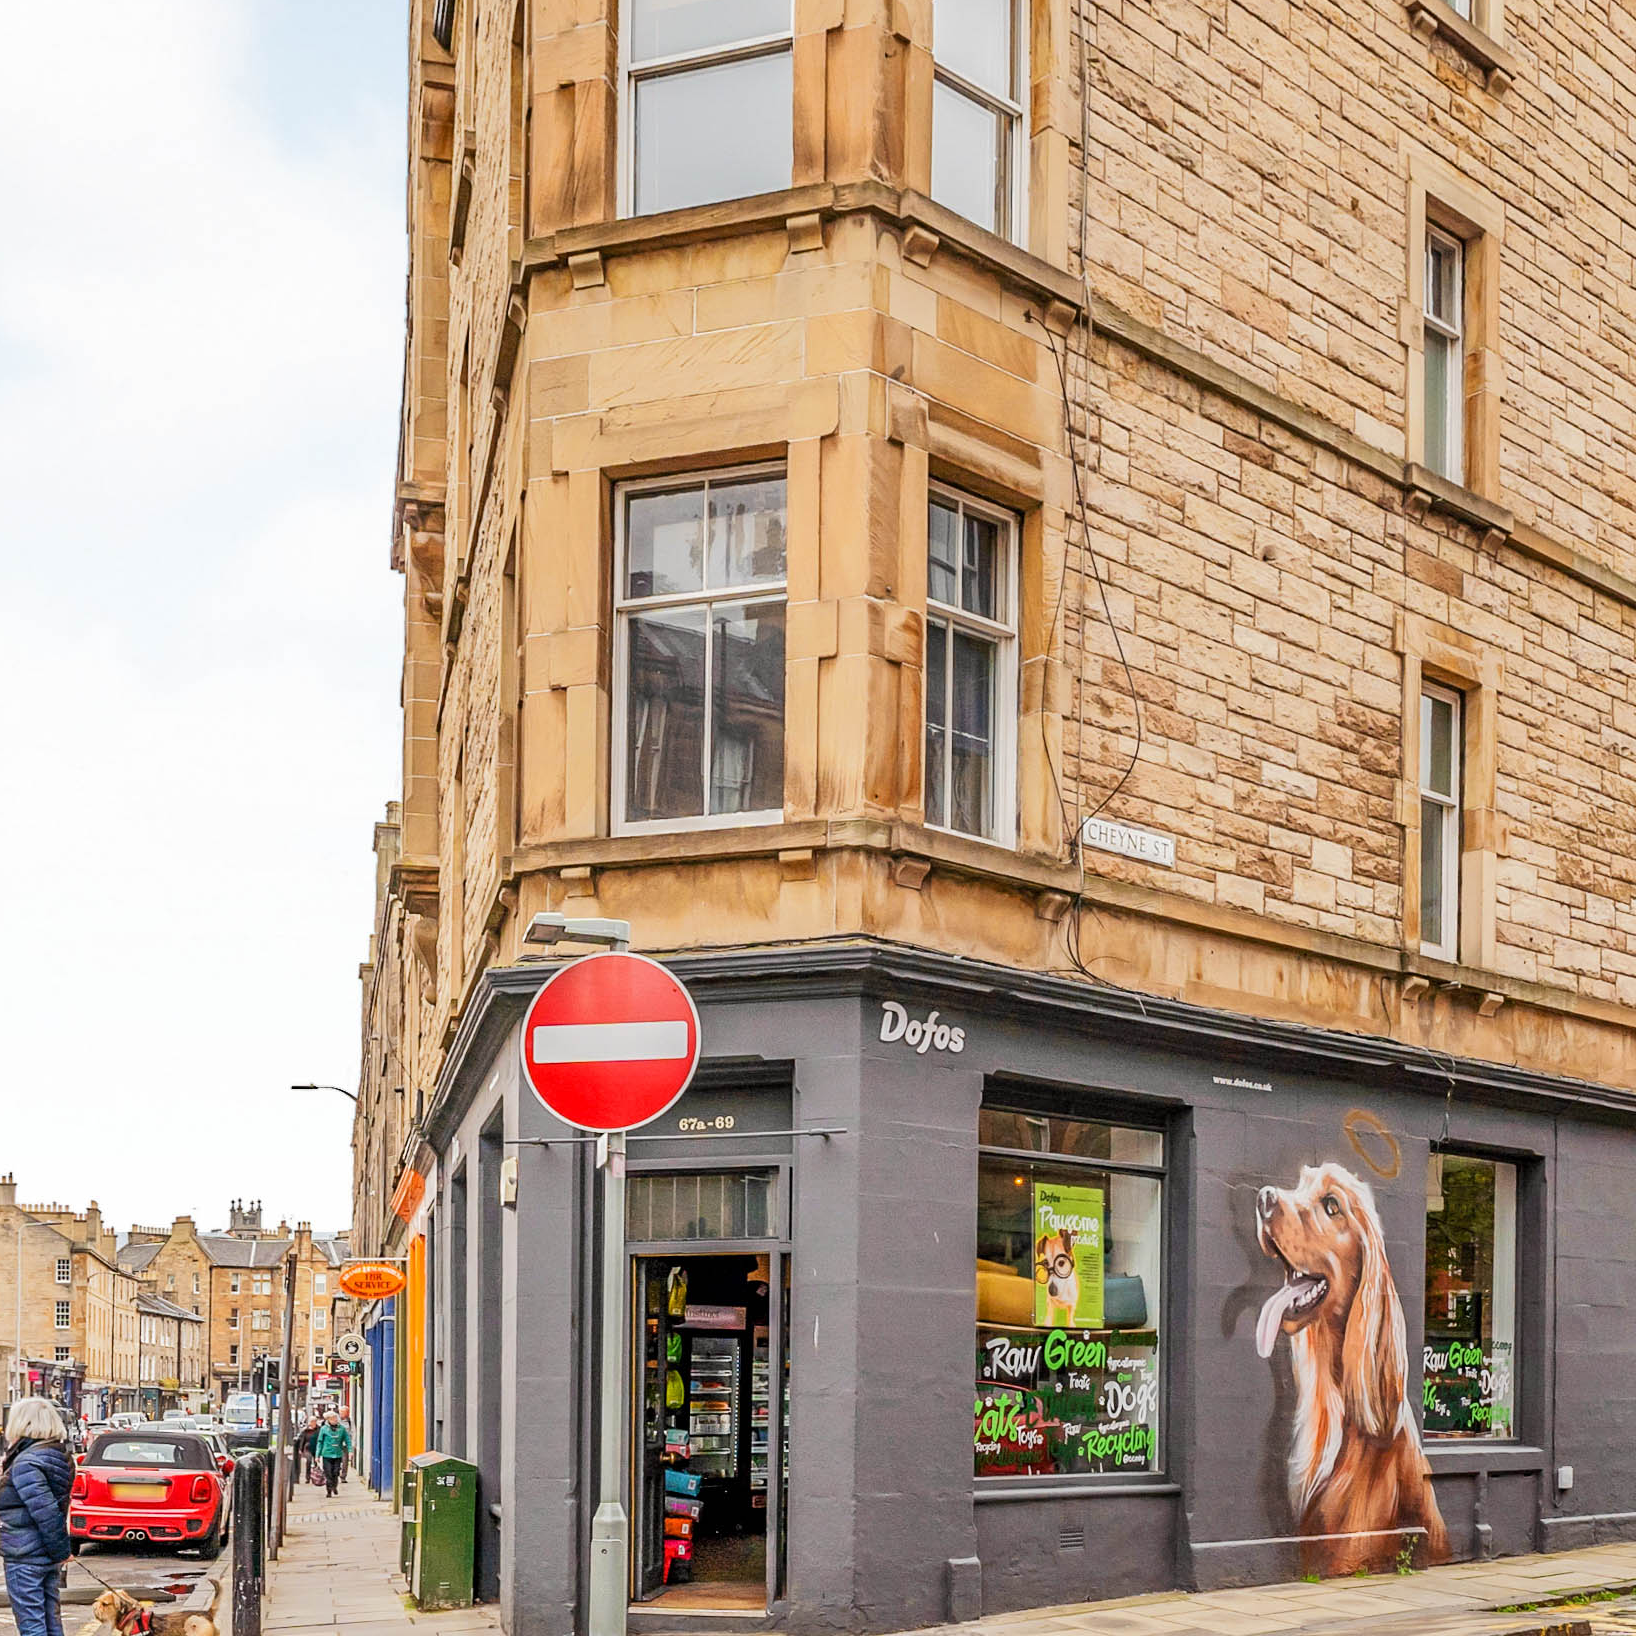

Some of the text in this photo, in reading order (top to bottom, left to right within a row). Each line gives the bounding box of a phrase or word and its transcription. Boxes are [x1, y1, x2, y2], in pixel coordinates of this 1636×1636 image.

[1088, 823, 1170, 859] CHEYNE ST
[880, 1001, 965, 1054] Dofos
[1038, 1205, 1099, 1234] Pawsome
[985, 1329, 1106, 1379] Raw Green
[1423, 1341, 1482, 1373] Raw Green
[1068, 1372, 1091, 1390] Treats
[1082, 1424, 1156, 1465] Recycling
